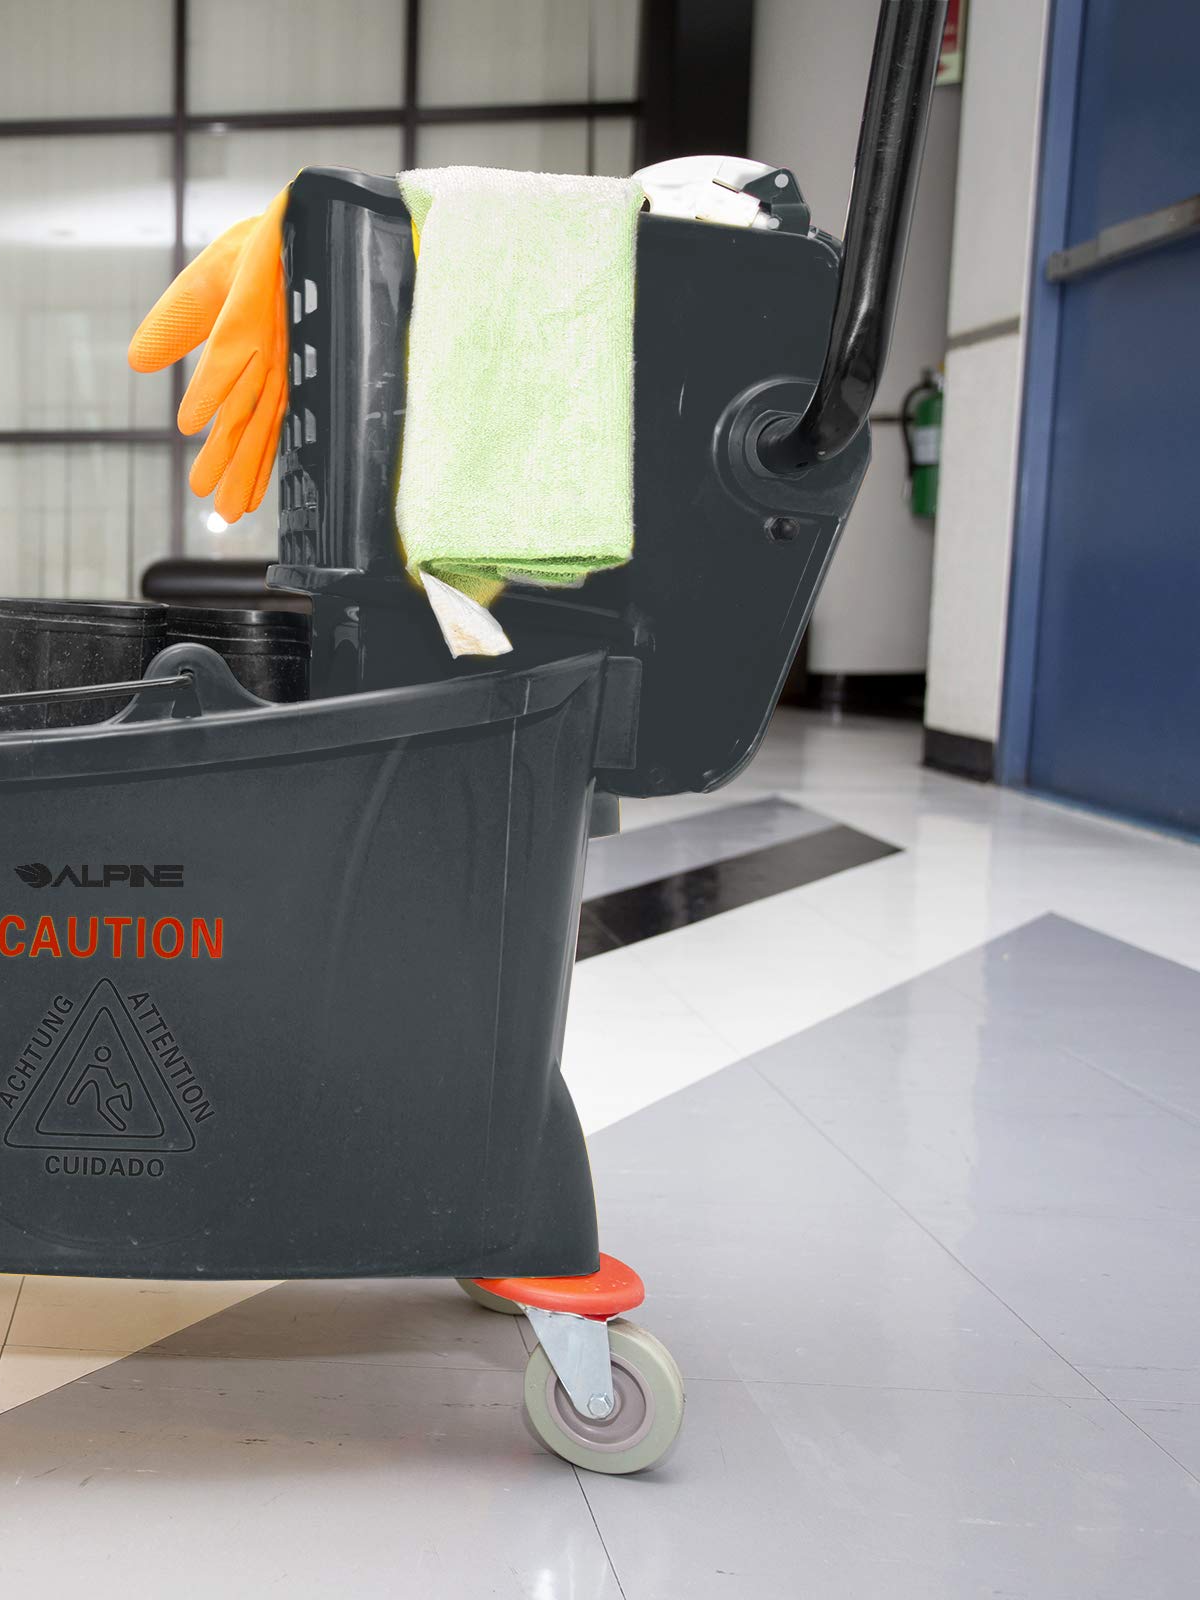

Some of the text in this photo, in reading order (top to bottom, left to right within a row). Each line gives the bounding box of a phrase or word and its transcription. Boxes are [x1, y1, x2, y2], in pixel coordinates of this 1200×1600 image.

[50, 864, 184, 888] ALPINE
[127, 991, 215, 1123] ATTENTION
[44, 1155, 165, 1178] CUIDADO
